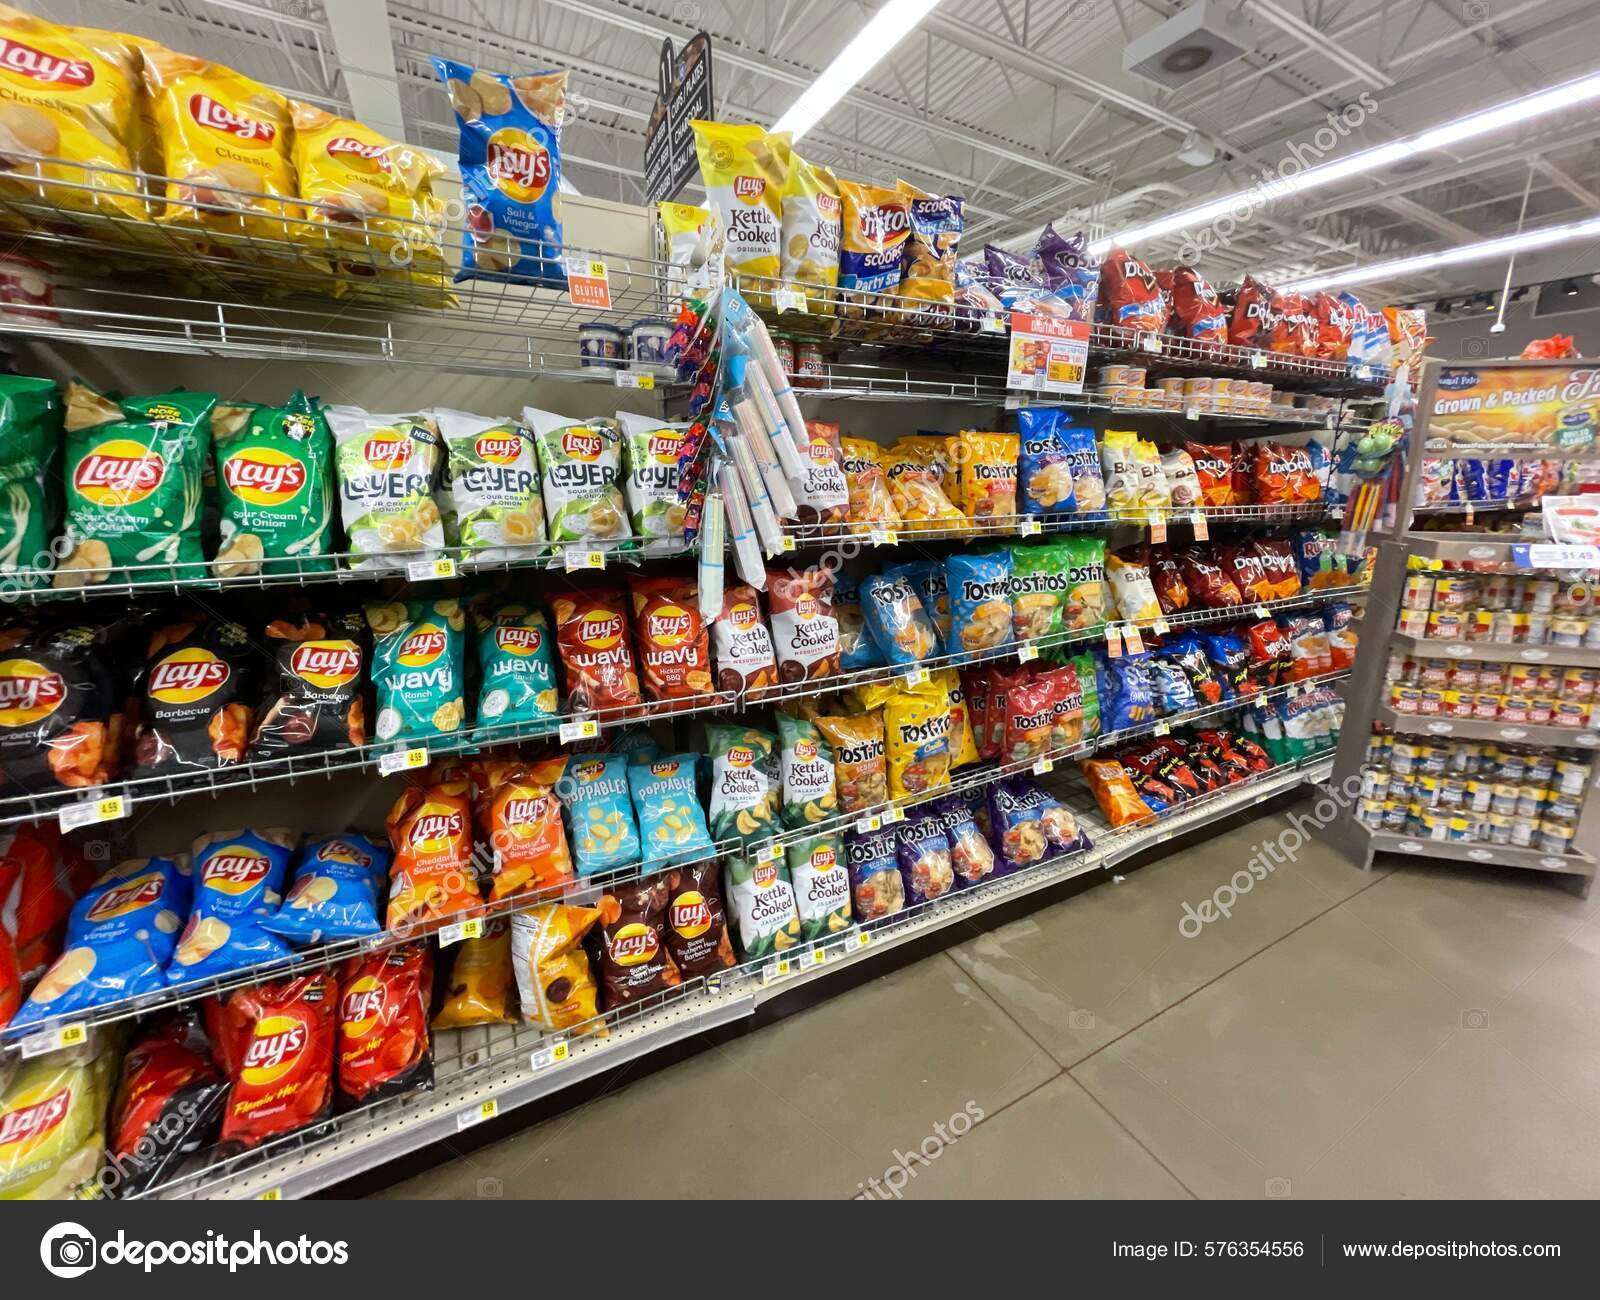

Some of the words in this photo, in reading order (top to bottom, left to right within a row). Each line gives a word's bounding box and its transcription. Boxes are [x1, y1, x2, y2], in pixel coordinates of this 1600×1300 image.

[196, 94, 275, 139] Lay's
[215, 146, 273, 170] Classic
[490, 144, 548, 186] Lay's
[736, 177, 765, 197] Lay's
[502, 214, 539, 230] Vinegar
[506, 206, 526, 219] Salt
[531, 212, 539, 221] &
[731, 209, 772, 227] Kettle
[727, 226, 776, 245] Cooked
[574, 285, 605, 300] GLUTEN
[855, 276, 884, 291] Party
[1434, 396, 1482, 415] Grown
[1485, 393, 1499, 404] &
[1502, 386, 1557, 406] Packed
[368, 442, 411, 461] Lay's
[478, 438, 522, 458] Lay's
[565, 435, 603, 455] Lay's
[80, 456, 159, 490] Lay's
[226, 461, 302, 493] Lay's
[233, 510, 258, 522] Sour
[259, 510, 298, 522] Cream
[252, 516, 287, 529] Onion
[797, 598, 817, 614] Lay's
[650, 612, 690, 637] Lay's
[730, 607, 756, 625] Lay's
[583, 616, 622, 641] Lay's
[731, 628, 767, 645] Kettle
[795, 619, 830, 638] Kettle
[499, 628, 541, 649] Lay's
[791, 629, 835, 650] Cooked
[577, 646, 632, 668] wavy
[646, 646, 698, 667] wavy
[729, 638, 772, 659] Cooked
[298, 646, 360, 673] Lay's
[152, 662, 225, 692] Lay's
[493, 658, 549, 682] wavy
[659, 666, 686, 678] Hickory
[665, 673, 682, 683] BBQ
[385, 667, 453, 694] wavy
[304, 689, 350, 702] Barbecue
[404, 688, 434, 701] Ranch
[155, 706, 211, 721] Barbecue
[408, 751, 423, 764] 4.59
[729, 748, 756, 764] Lay's
[794, 744, 818, 758] Lay's
[652, 761, 680, 775] Lay's
[724, 769, 757, 785] Kettle
[791, 762, 826, 778] Kettle
[721, 780, 761, 795] Cooked
[788, 773, 830, 787] Cooked
[101, 801, 120, 815] 4.59
[509, 797, 549, 825] Lay's
[412, 814, 463, 843] Lay's
[416, 855, 451, 867] Cheddar
[810, 851, 836, 868] Lay's
[204, 856, 269, 883] Lay's
[413, 864, 433, 876] Sour
[753, 866, 777, 883] Lay's
[810, 869, 845, 890] Kettle
[97, 878, 162, 914] Lay's
[753, 885, 787, 906] Kettle
[808, 880, 850, 902] Cooked
[674, 901, 711, 929] Lay's
[751, 896, 793, 921] Cooked
[614, 931, 656, 960] Lay's
[677, 944, 704, 957] Southern
[703, 940, 718, 949] Heat
[685, 948, 712, 962] Barbecue
[63, 1026, 81, 1041] 4.59
